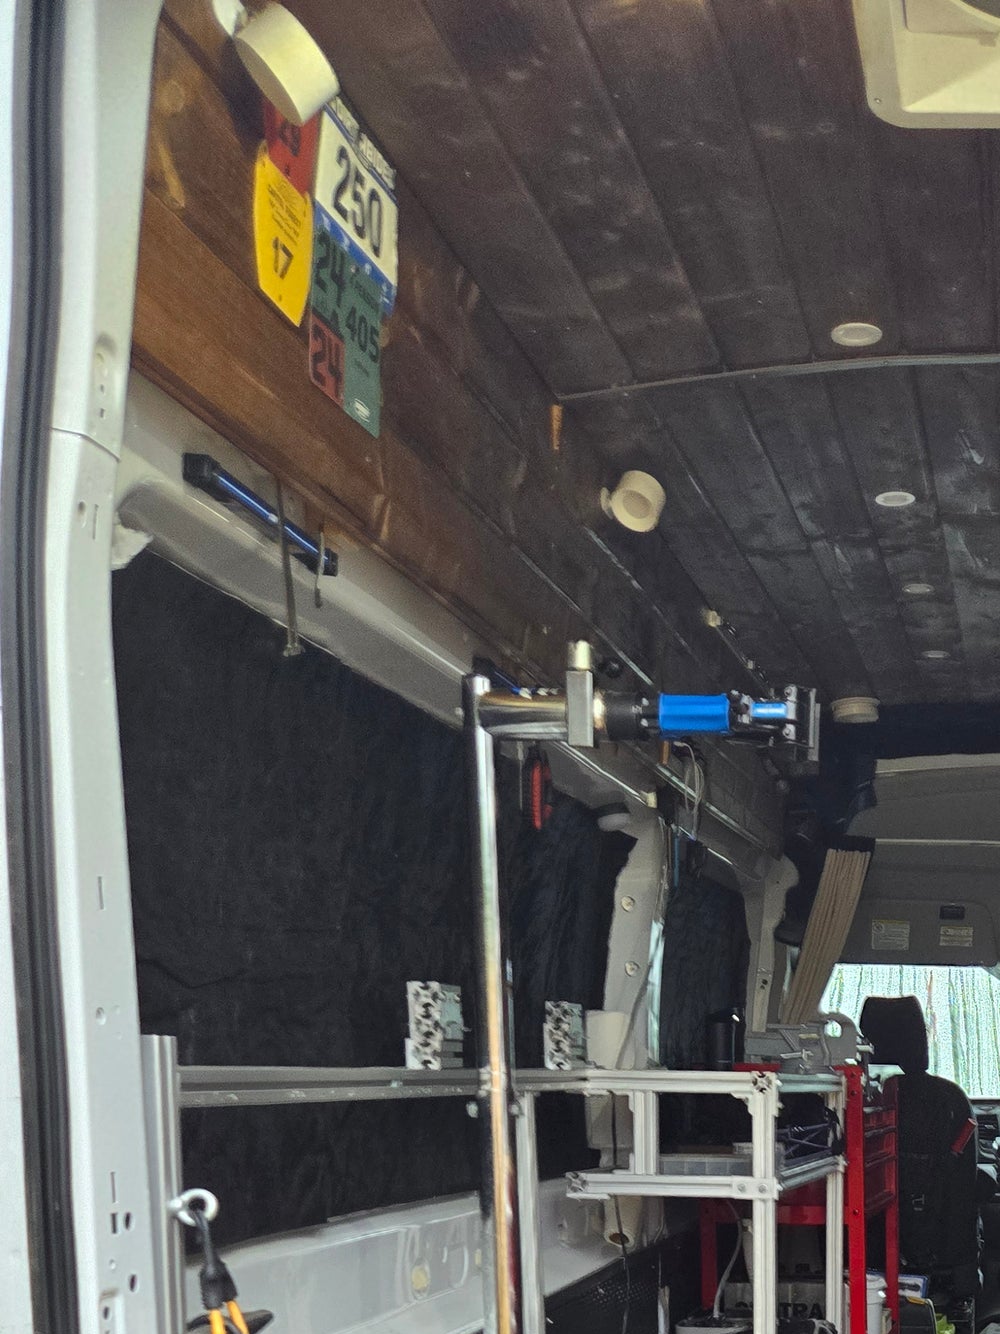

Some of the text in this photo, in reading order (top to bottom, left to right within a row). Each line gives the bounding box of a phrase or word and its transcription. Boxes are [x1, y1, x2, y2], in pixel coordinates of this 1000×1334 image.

[333, 145, 382, 258] 250
[272, 236, 294, 280] 17
[315, 232, 346, 307] 24
[345, 306, 380, 363] 405
